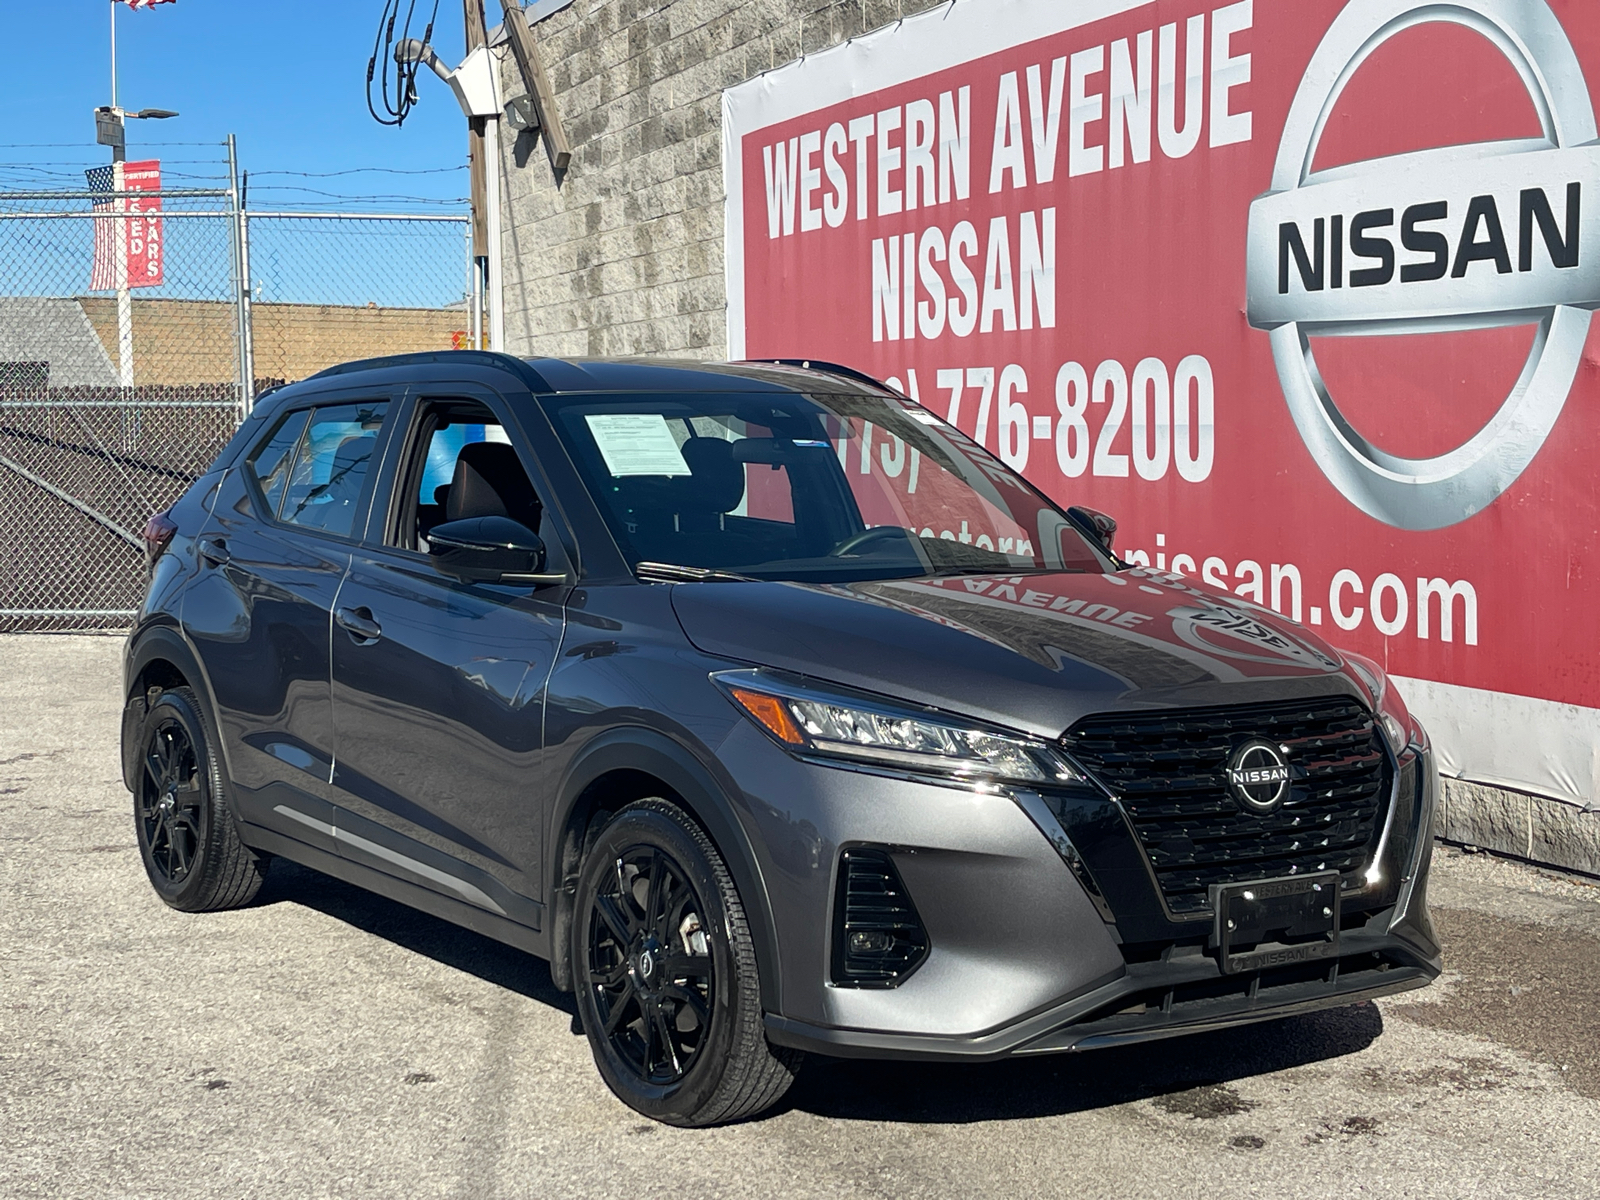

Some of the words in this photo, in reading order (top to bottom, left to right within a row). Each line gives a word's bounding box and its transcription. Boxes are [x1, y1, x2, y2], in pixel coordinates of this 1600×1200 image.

[763, 85, 970, 239] WESTERN
[989, 0, 1253, 194] AVENUE
[125, 171, 159, 180] CERTIFIED
[146, 207, 159, 277] CARS
[872, 207, 1056, 342] NISSAN
[1278, 181, 1581, 294] NISSAN
[936, 355, 1215, 483] 776-8200
[1232, 768, 1289, 784] NISSAN
[1258, 947, 1308, 968] NISSAN
